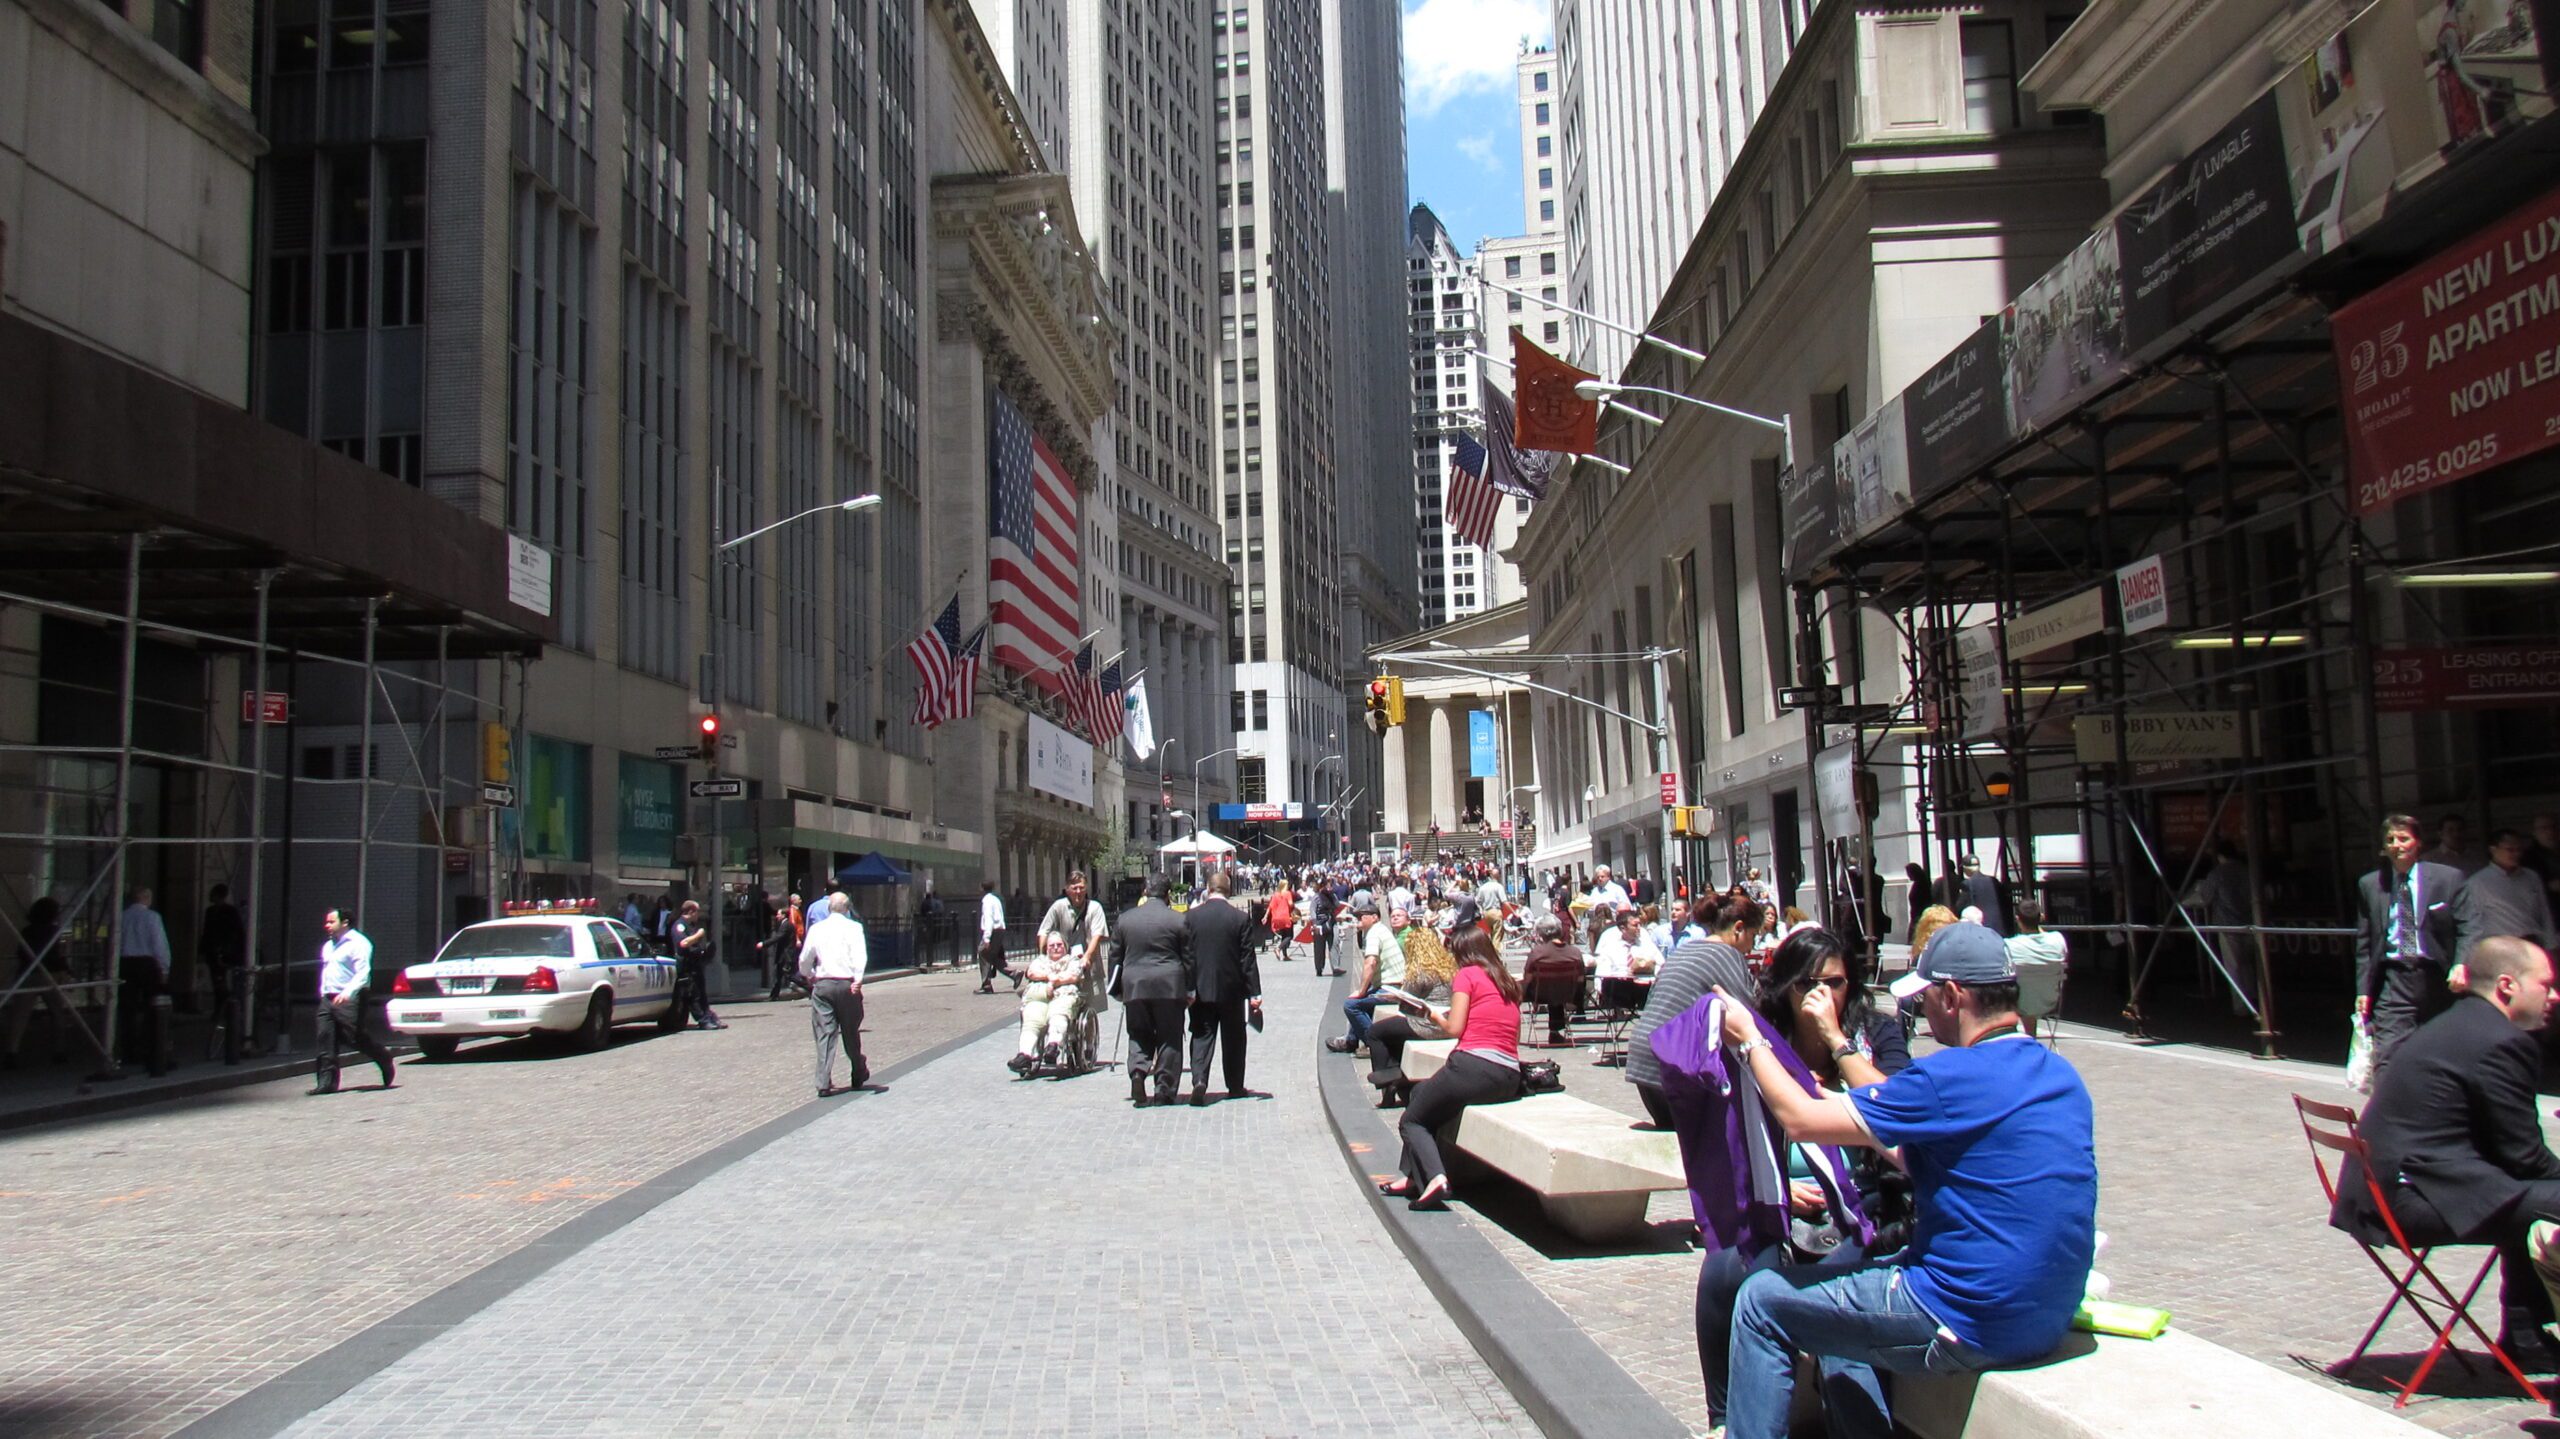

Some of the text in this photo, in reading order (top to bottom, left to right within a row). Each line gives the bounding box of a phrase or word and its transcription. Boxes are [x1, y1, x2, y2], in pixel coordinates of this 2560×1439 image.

[2204, 128, 2253, 180] LIVABLE
[2422, 250, 2493, 318] NEW
[2426, 274, 2560, 370] APARTM
[1961, 348, 1977, 369] FUN
[2350, 321, 2409, 395] 25
[2450, 345, 2560, 418] NOW LE
[2356, 392, 2400, 422] BROAD
[2360, 433, 2499, 507] 212.425.0025
[2120, 566, 2161, 607] DANGER
[2008, 626, 2036, 649] BOBBY
[2373, 659, 2423, 685] 25
[2442, 652, 2521, 669] LEASING
[2468, 671, 2560, 689] ENTRANC
[2101, 714, 2233, 736] BBBY VAN'S
[634, 789, 654, 808] NYSE
[697, 785, 734, 794] ONE WAY
[634, 809, 673, 830] EURONEXT
